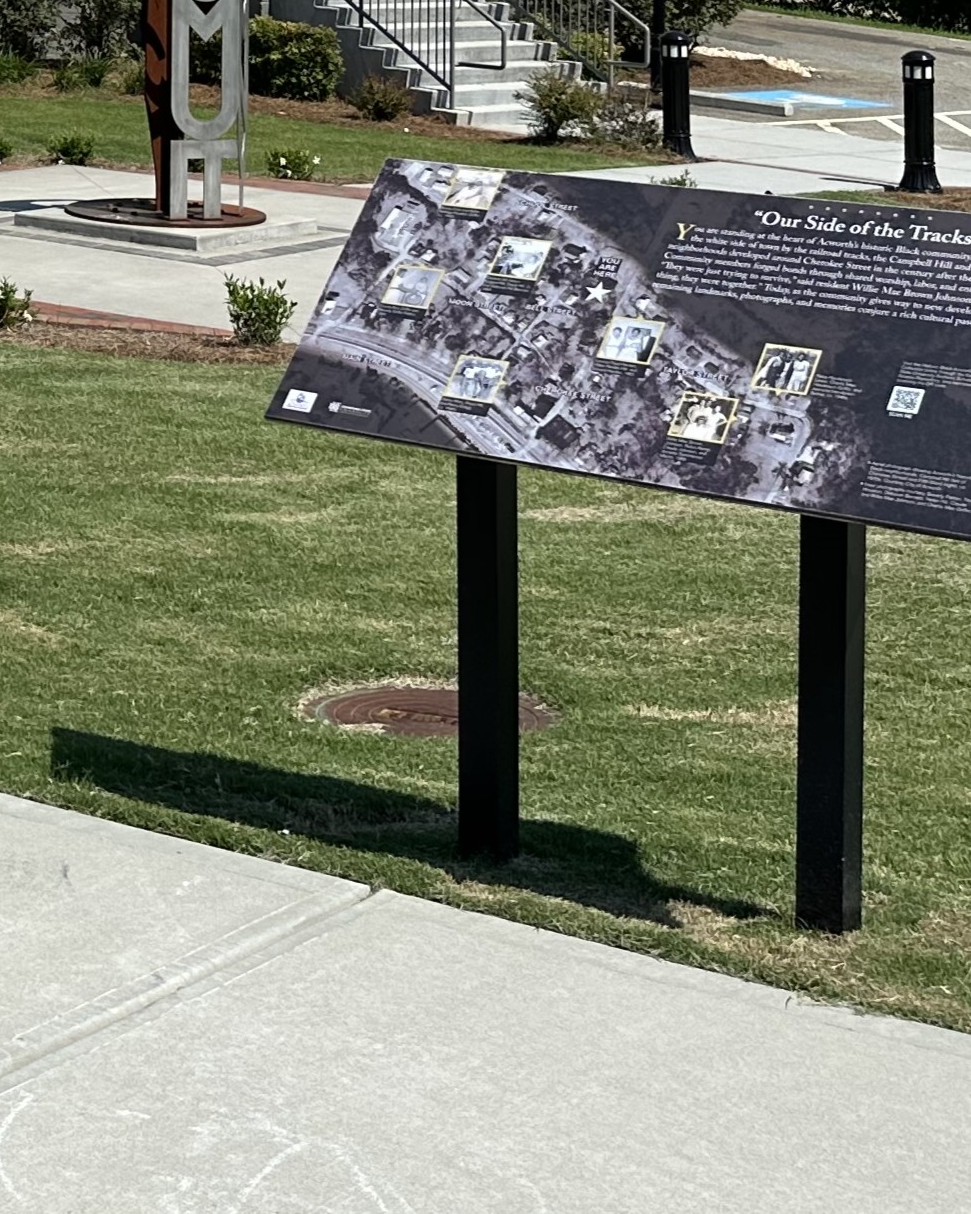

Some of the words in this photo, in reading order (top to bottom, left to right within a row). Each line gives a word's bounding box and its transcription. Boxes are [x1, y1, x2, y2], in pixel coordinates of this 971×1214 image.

[754, 210, 801, 228] “Our
[804, 215, 845, 233] Side
[850, 221, 875, 235] of
[874, 223, 905, 239] the
[691, 235, 704, 243] the
[706, 236, 727, 245] white
[730, 239, 747, 247] side
[759, 243, 780, 251] town
[782, 244, 791, 254] by
[794, 246, 807, 254] the
[810, 248, 842, 257] railroad
[873, 254, 886, 262] the
[889, 255, 932, 267] Campbell
[934, 260, 953, 269] Hill
[720, 229, 755, 240] standing
[768, 232, 780, 240] the
[782, 233, 804, 242] heart
[806, 236, 817, 244] of
[818, 237, 860, 248] Acworth’s
[861, 241, 893, 251] historic
[895, 244, 920, 254] Black
[593, 270, 617, 278] HERE
[601, 256, 621, 265] YOU
[664, 250, 712, 265] Community
[714, 258, 751, 267] members
[753, 260, 779, 272] forged
[782, 263, 807, 273] bonds
[810, 267, 842, 279] through
[845, 271, 873, 281] shared
[939, 283, 957, 291] and
[668, 244, 727, 255] neighborhoods
[729, 248, 770, 261] developed
[771, 255, 801, 263] around
[803, 256, 844, 268] Cherokee
[845, 261, 871, 271] Street
[885, 265, 899, 274] the
[900, 269, 934, 280] century
[936, 271, 956, 280] after
[681, 274, 698, 285] they
[803, 288, 817, 296] the
[819, 292, 867, 304] community
[868, 297, 892, 305] gives
[894, 301, 911, 309] way
[705, 268, 721, 276] just
[723, 269, 747, 280] trying
[815, 281, 849, 290] resident
[852, 283, 879, 293] Willie
[881, 286, 901, 295] Mae
[904, 289, 933, 299] Brown
